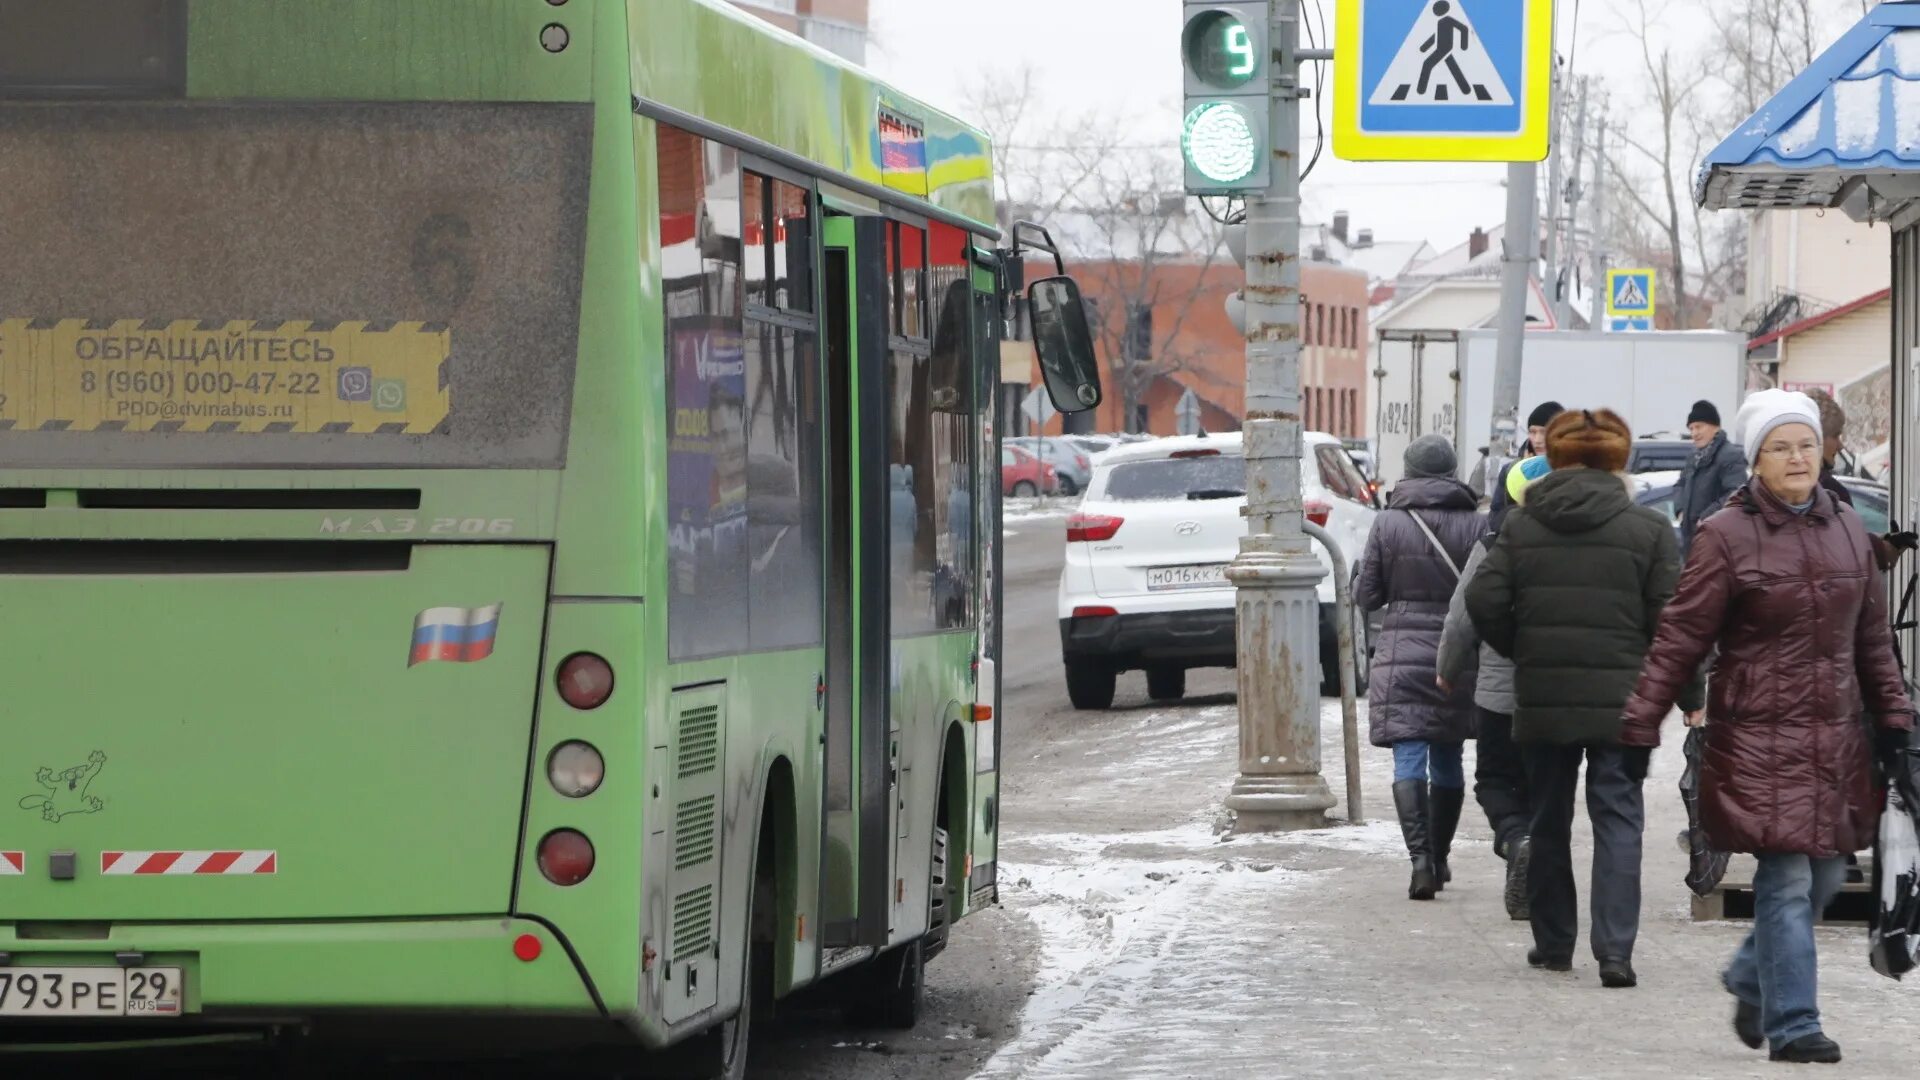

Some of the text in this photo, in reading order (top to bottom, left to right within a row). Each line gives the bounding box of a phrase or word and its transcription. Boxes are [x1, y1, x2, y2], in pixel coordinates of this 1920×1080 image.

[1227, 24, 1254, 76] 9
[75, 331, 335, 366] ОБРАЩАЙТЕСЬ
[80, 370, 320, 398] 8 (960) 000-47-22
[117, 400, 293, 419] PDD@dvinabus.ru
[319, 516, 515, 534] МАЗ 206
[130, 972, 167, 1000] 29
[128, 1000, 156, 1011] RUS
